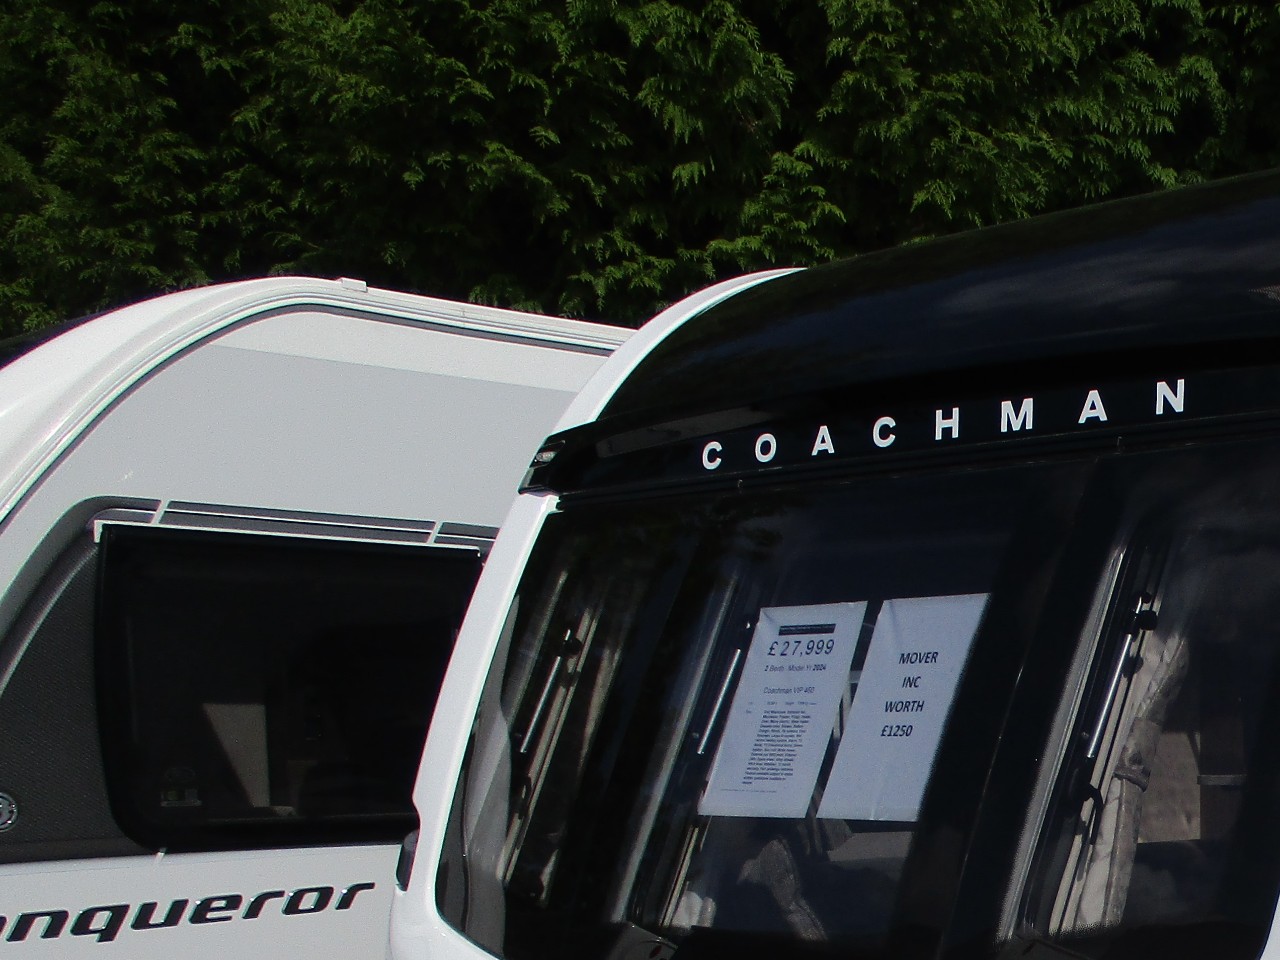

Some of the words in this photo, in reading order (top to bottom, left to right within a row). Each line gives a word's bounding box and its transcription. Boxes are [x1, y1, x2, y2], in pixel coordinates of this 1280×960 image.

[702, 378, 1185, 470] COACHMAN
[767, 639, 835, 657] £27,999
[899, 651, 938, 664] MOVER
[902, 676, 921, 688] INC
[884, 700, 924, 712] WORTH
[880, 725, 913, 737] £1250
[0, 882, 375, 942] nqueror
